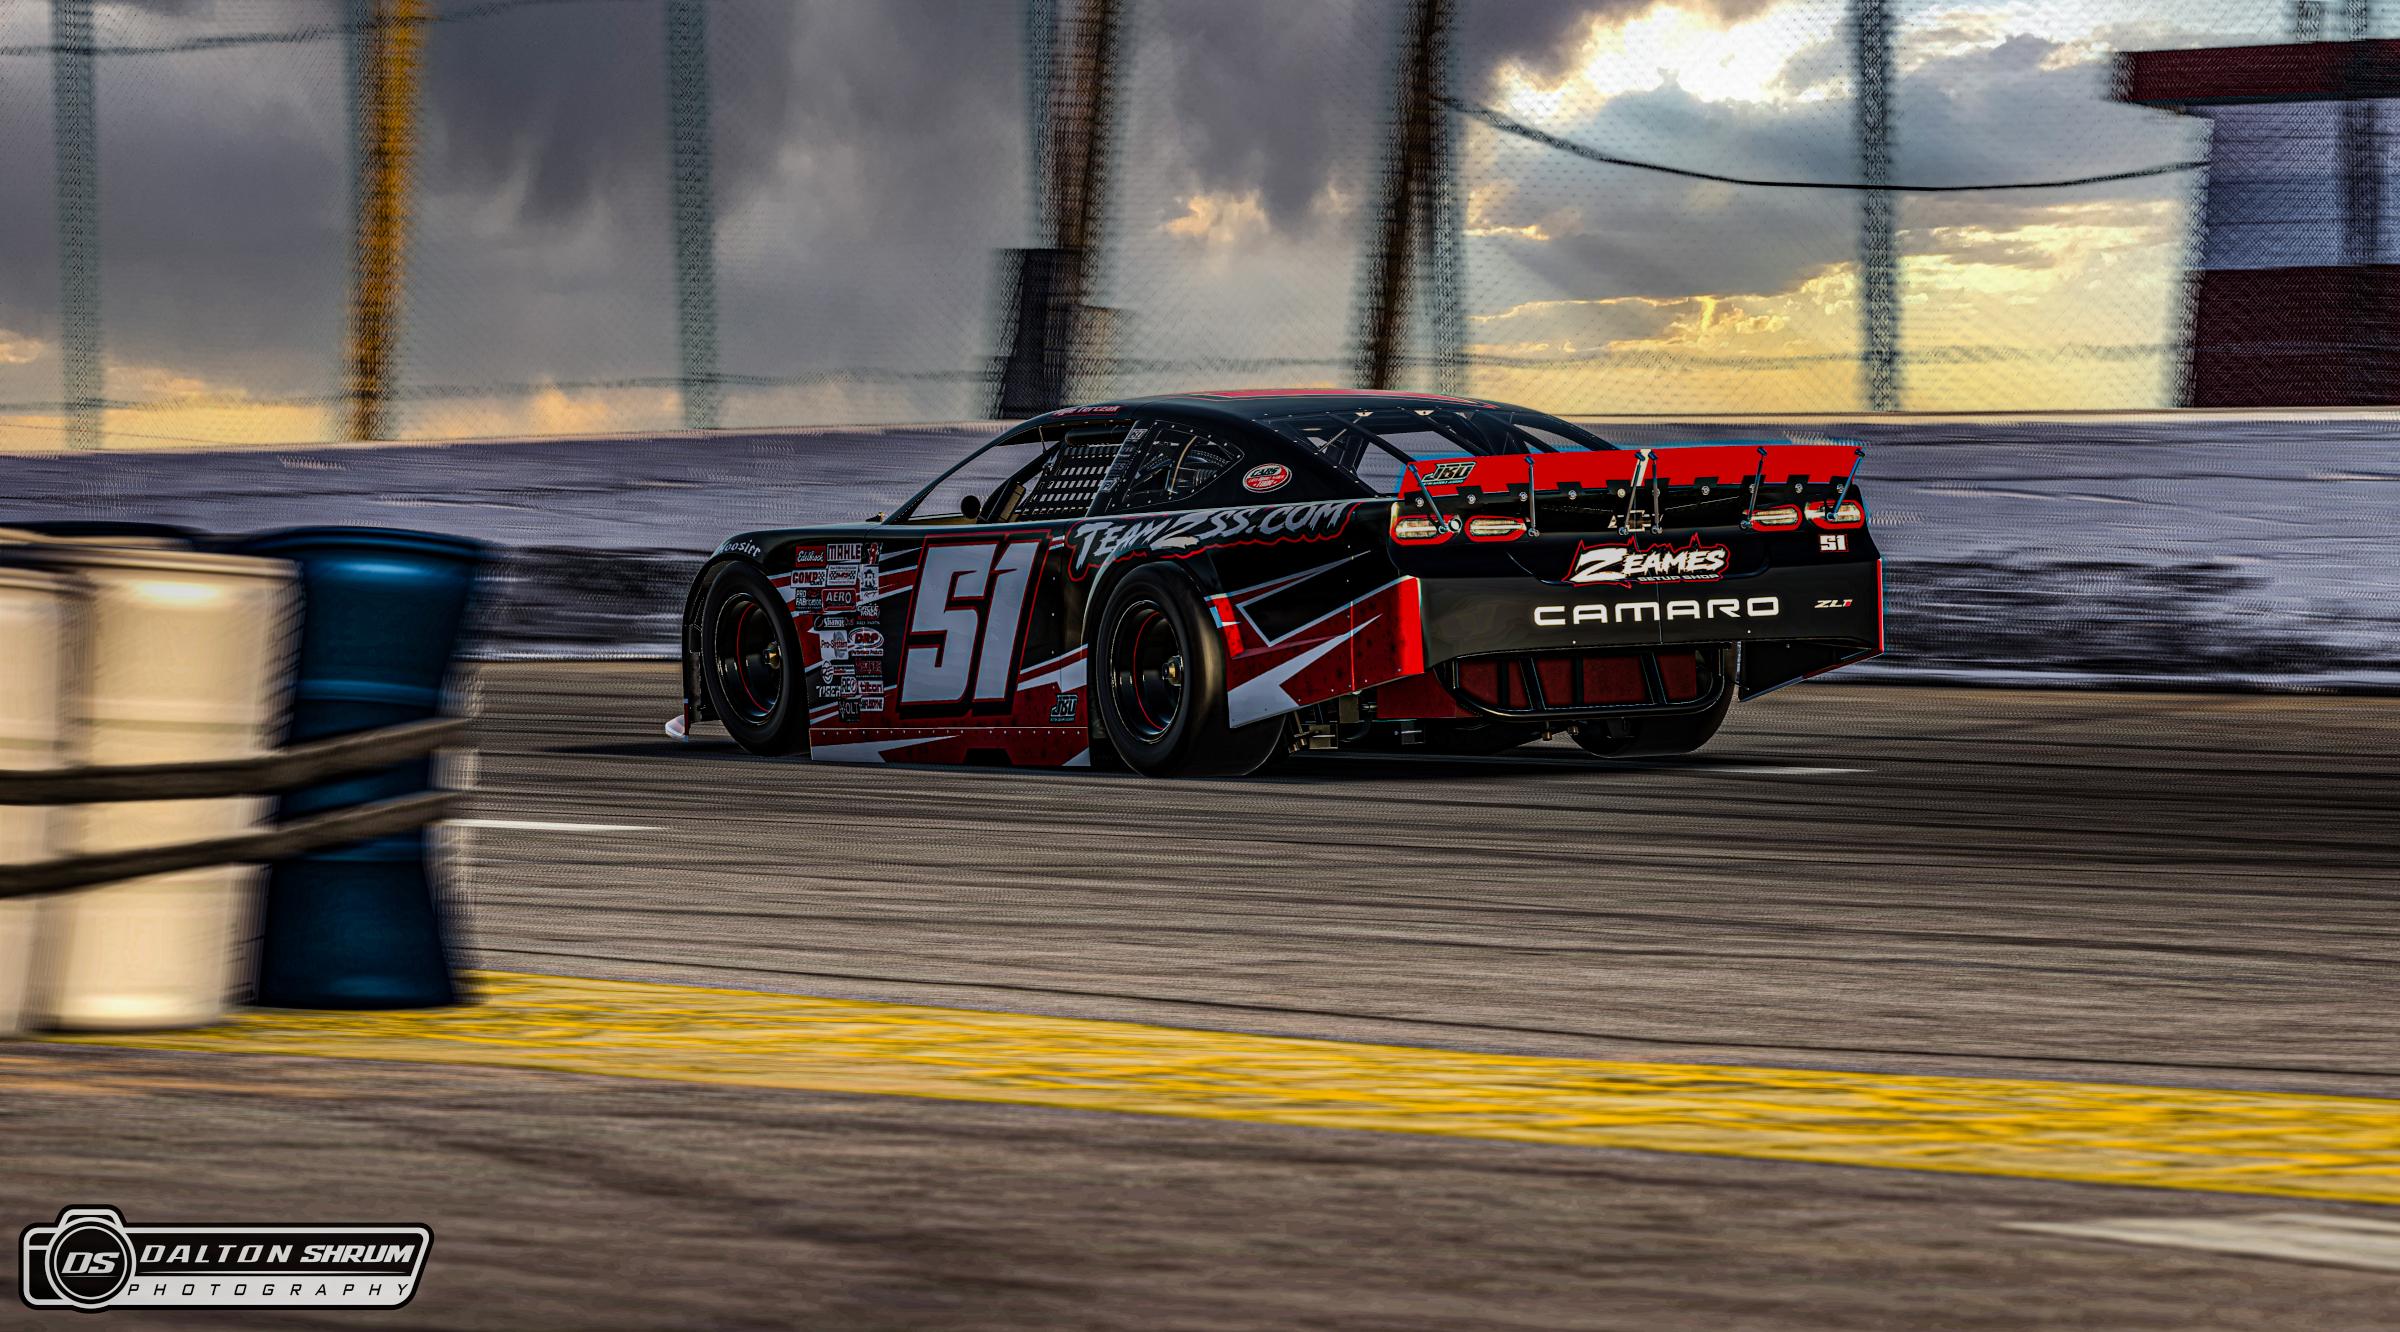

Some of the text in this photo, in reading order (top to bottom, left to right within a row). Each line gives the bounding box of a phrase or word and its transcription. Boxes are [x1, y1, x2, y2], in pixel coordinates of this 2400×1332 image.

[1820, 535, 1847, 551] 51
[829, 545, 861, 560] MAHLE
[1570, 548, 1726, 582] ZEAMES
[792, 572, 818, 585] COMP
[826, 592, 852, 604] AERO
[1814, 599, 1853, 608] ZL1
[1534, 596, 1780, 626] CAMARO
[901, 541, 1040, 703] 51
